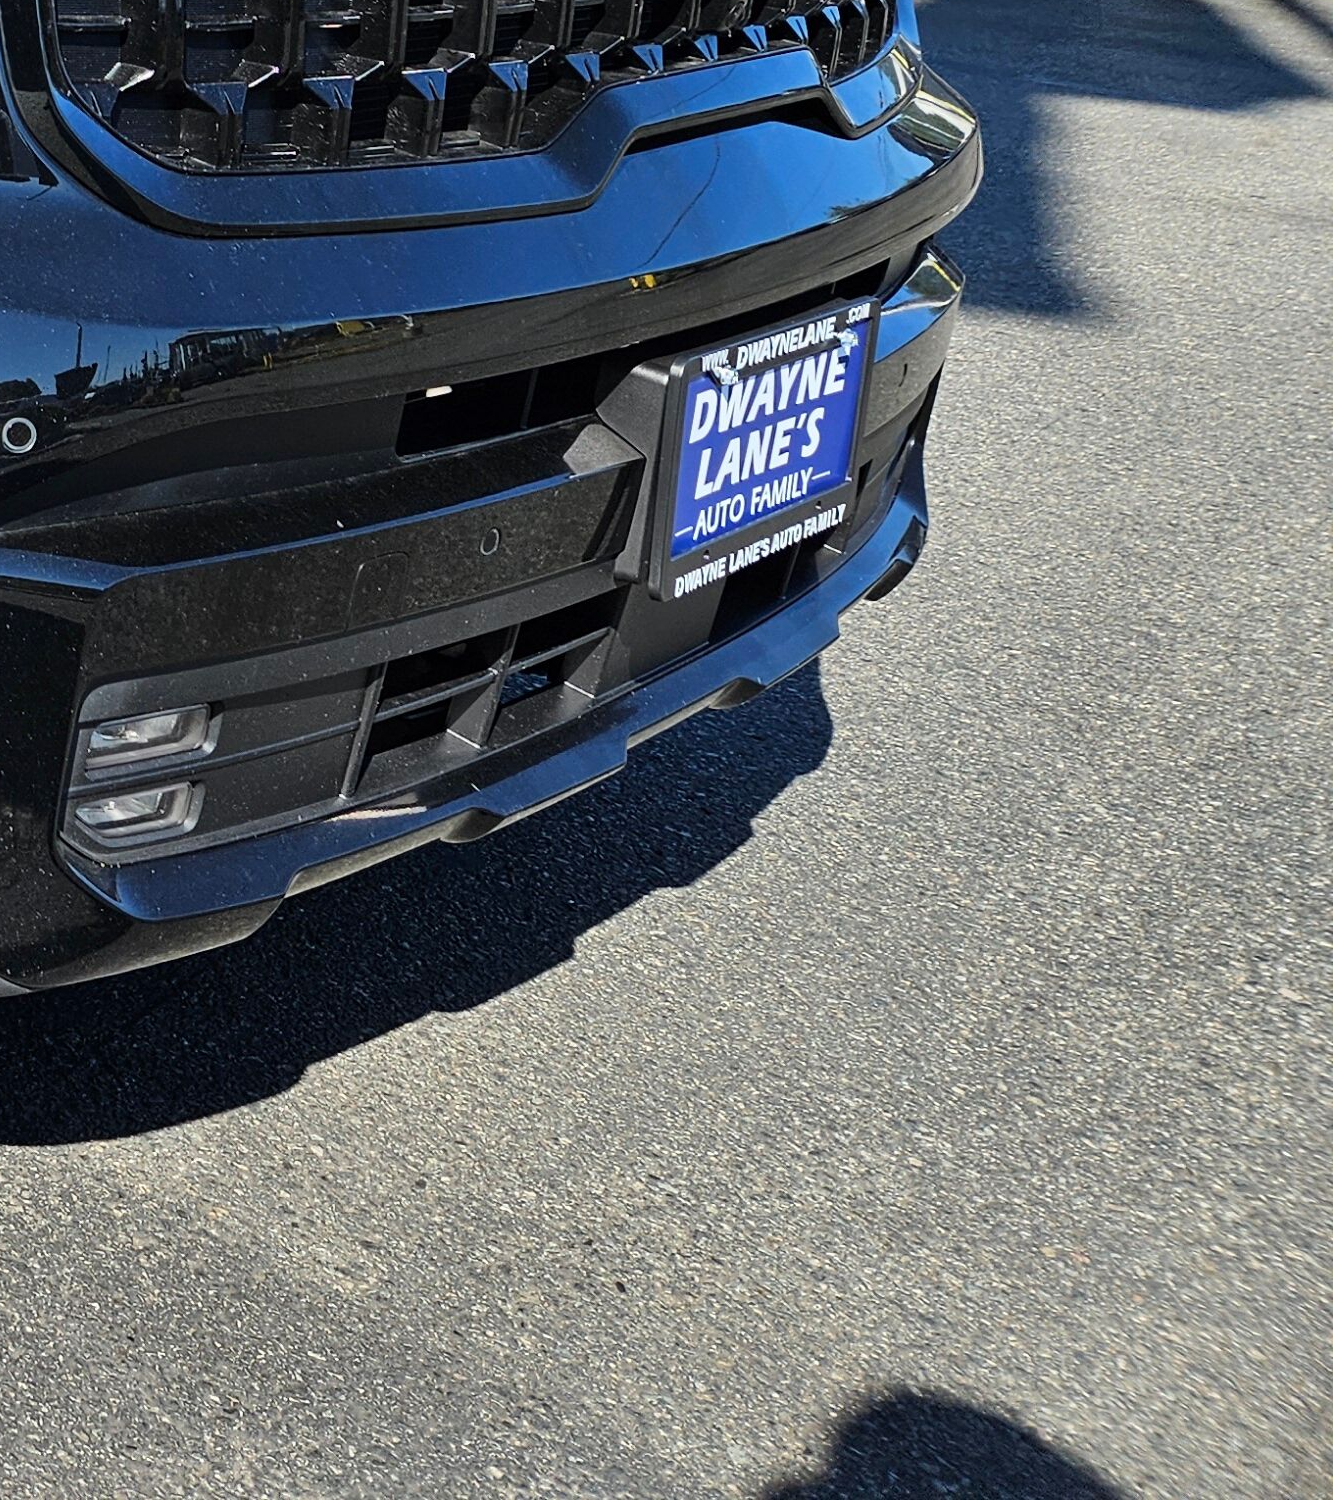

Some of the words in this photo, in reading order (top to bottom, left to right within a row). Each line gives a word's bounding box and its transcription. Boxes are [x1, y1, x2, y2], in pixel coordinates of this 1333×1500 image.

[736, 316, 837, 370] DWAYNELANE
[689, 347, 846, 444] DWAYNE
[694, 407, 825, 500] LANE'S
[674, 556, 728, 598] DWAYNE
[770, 523, 802, 555] AUTO
[803, 503, 847, 538] FAMILY
[692, 493, 745, 541] AUTO
[750, 467, 814, 516] FAMILY
